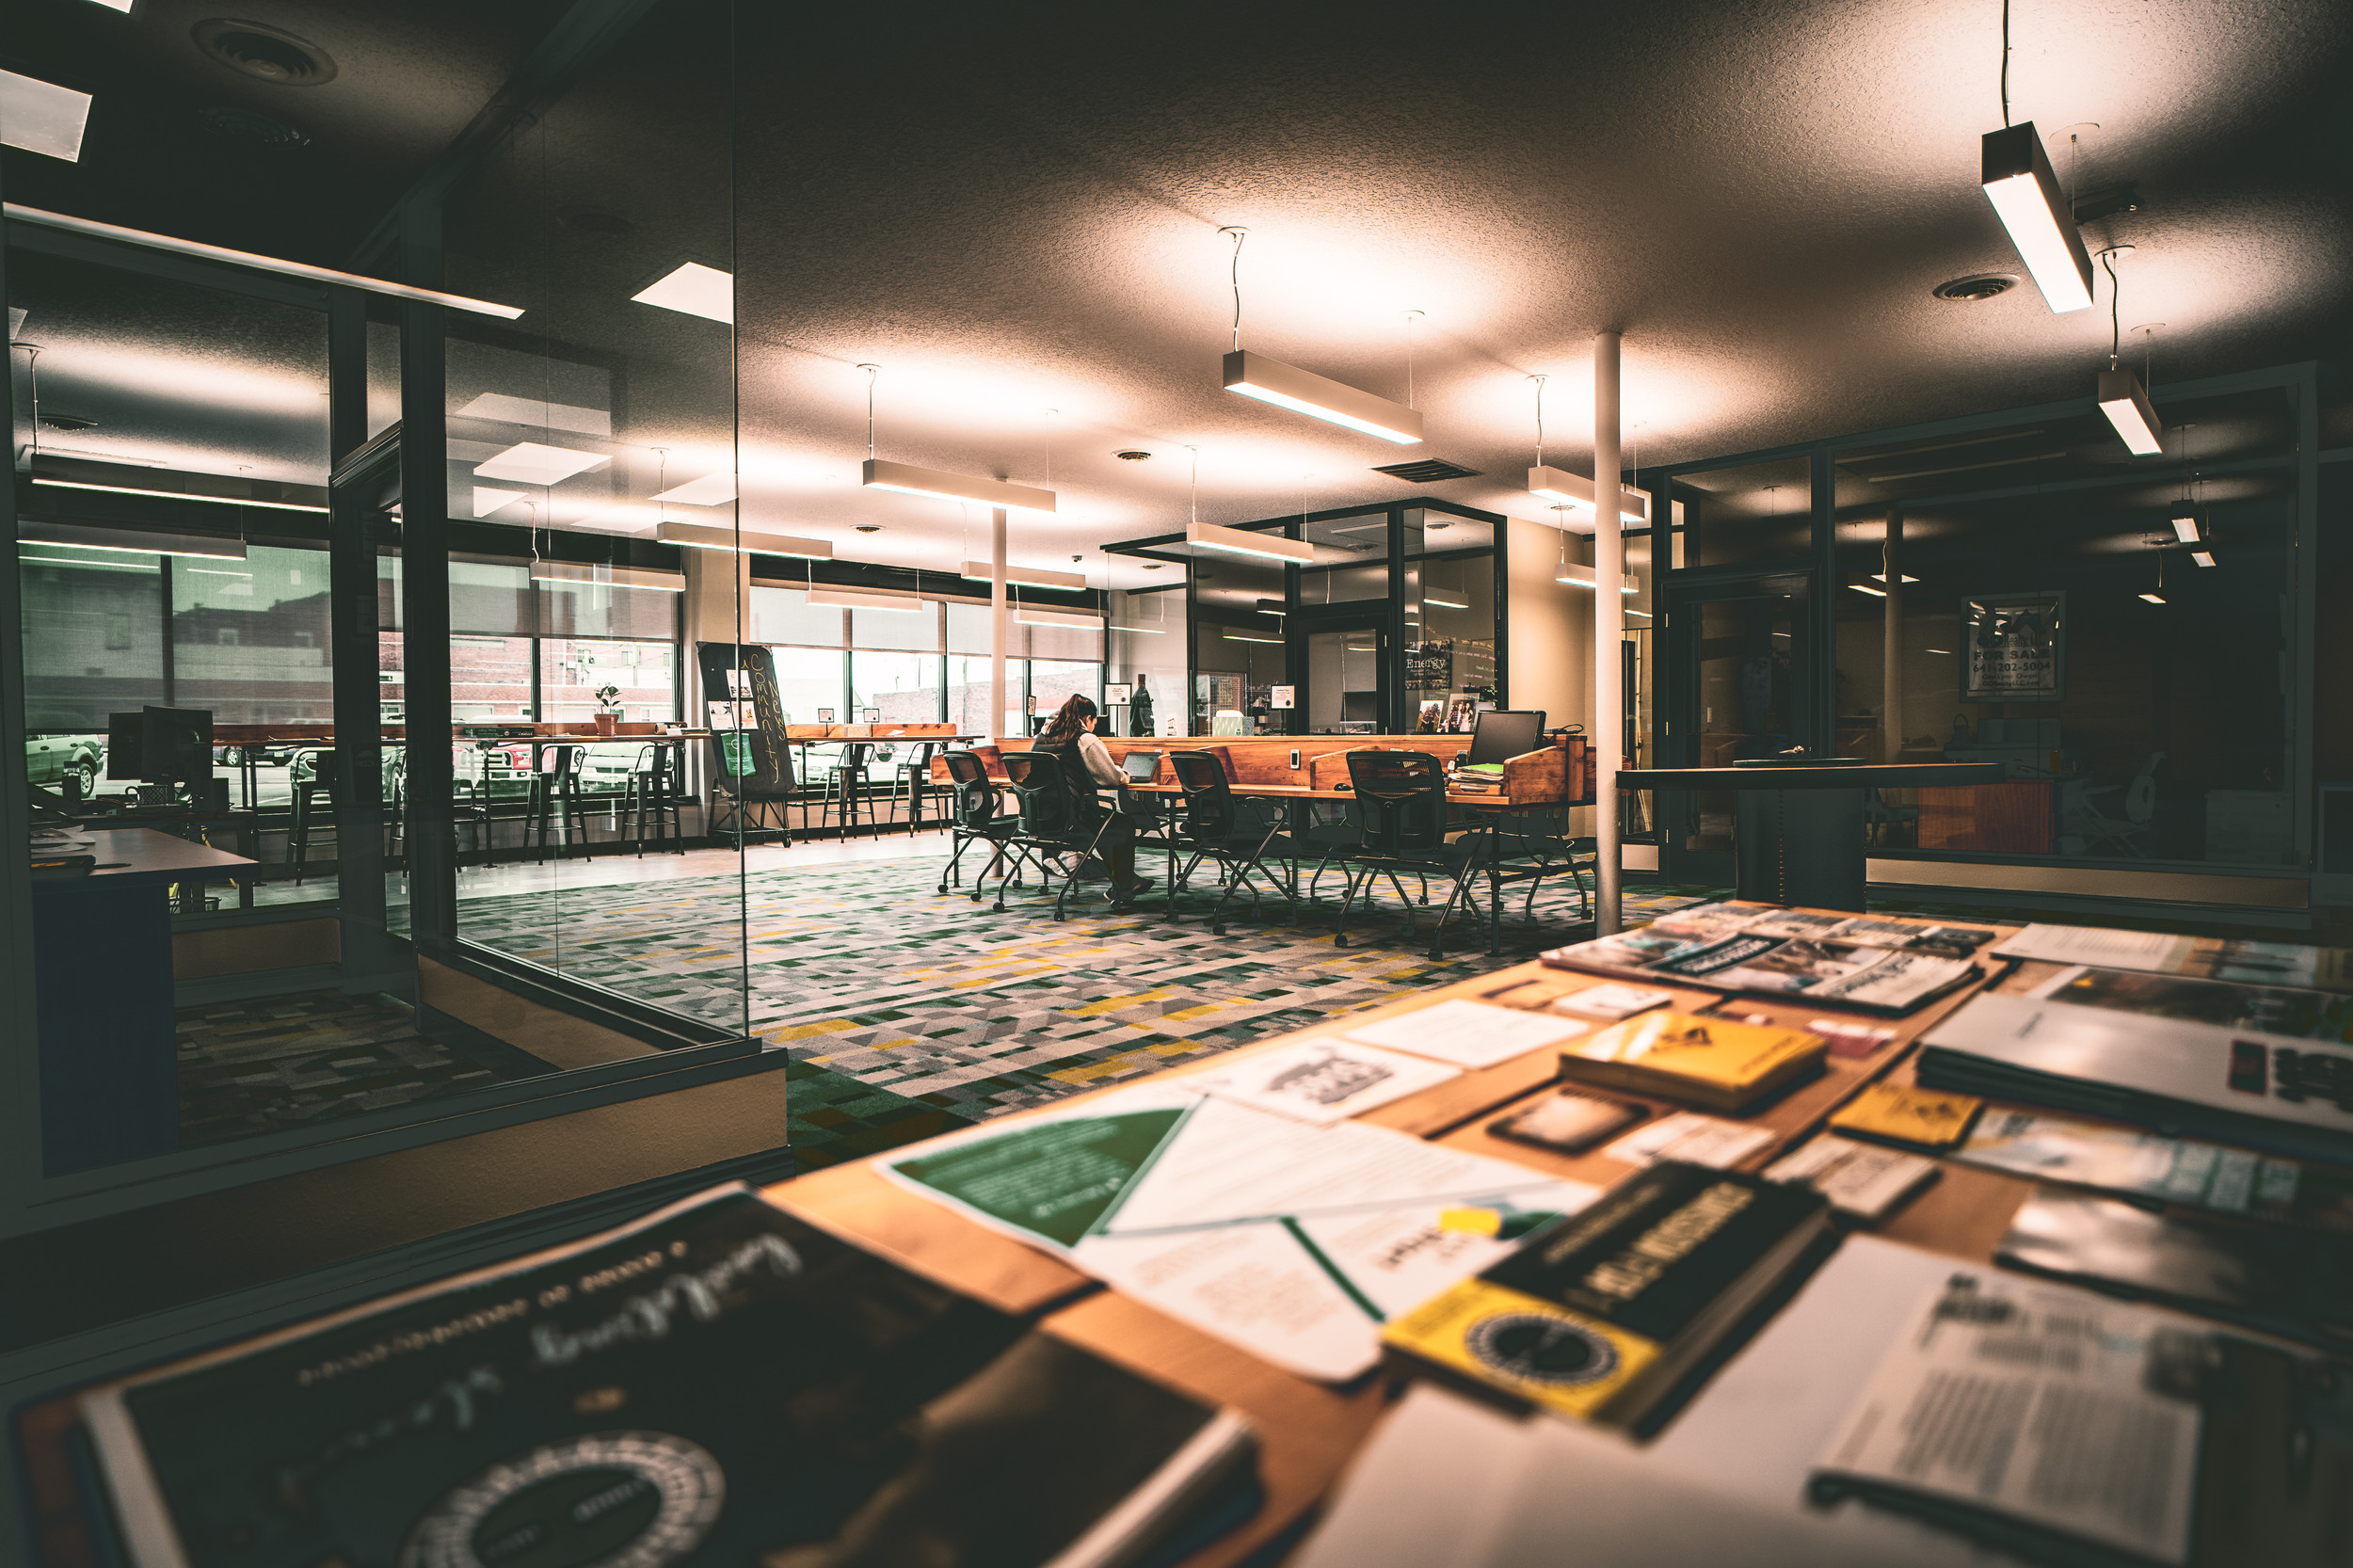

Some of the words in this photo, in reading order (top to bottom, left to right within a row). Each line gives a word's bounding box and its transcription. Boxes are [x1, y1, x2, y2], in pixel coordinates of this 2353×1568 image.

[1974, 650, 2004, 661] FOR
[2009, 648, 2049, 659] SALE
[1406, 658, 1446, 669] Energy
[1973, 662, 2050, 672] 641-202-5004
[768, 676, 786, 741] News
[750, 653, 779, 784] Community
